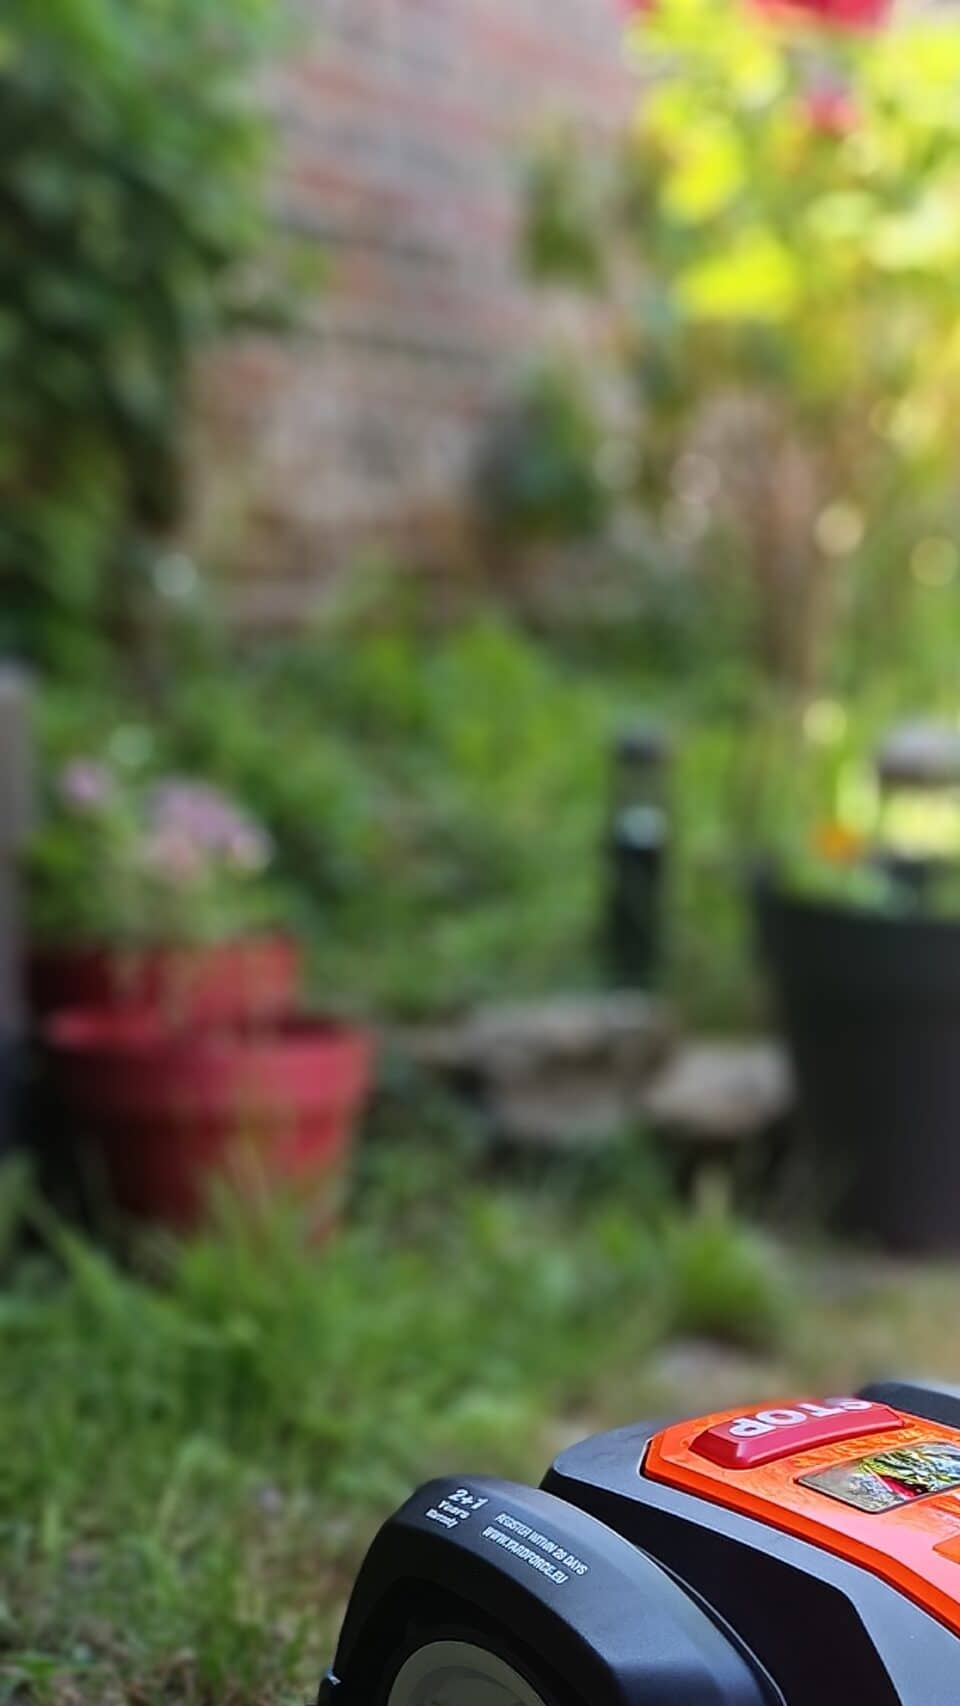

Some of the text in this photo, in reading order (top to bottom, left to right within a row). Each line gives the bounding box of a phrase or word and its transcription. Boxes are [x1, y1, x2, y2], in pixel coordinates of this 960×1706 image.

[728, 1397, 872, 1437] STOP
[437, 1500, 470, 1520] Years
[448, 1488, 488, 1511] 2+1
[563, 1556, 589, 1576] DAYS
